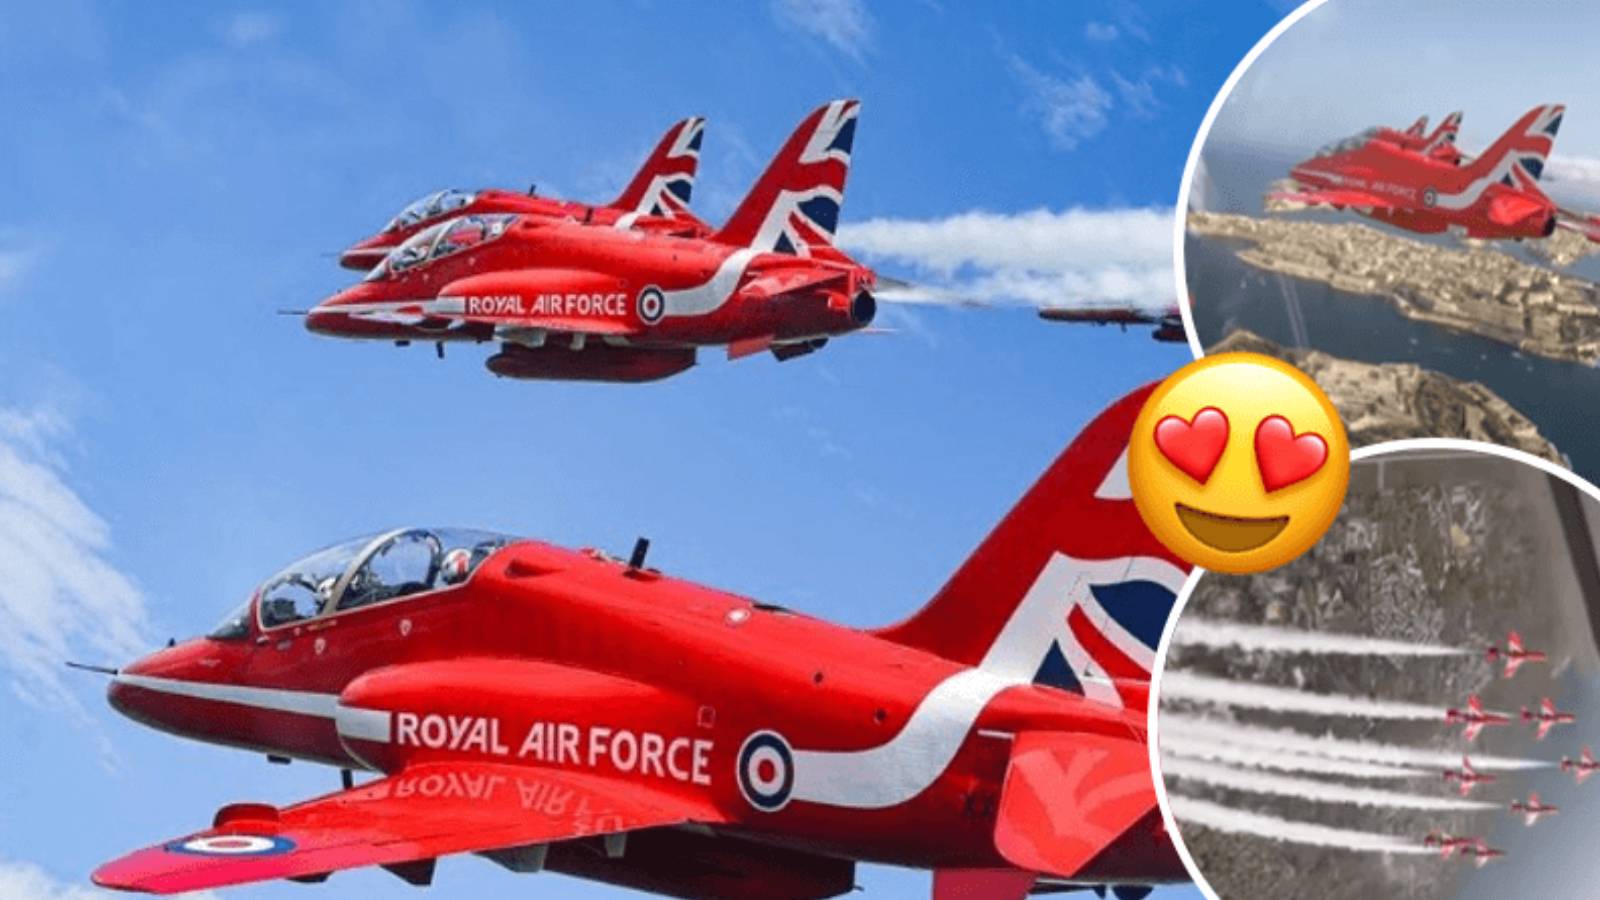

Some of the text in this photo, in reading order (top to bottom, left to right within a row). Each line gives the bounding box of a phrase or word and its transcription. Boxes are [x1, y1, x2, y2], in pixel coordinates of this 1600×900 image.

[469, 293, 627, 315] ROYAL AIR FORCE
[398, 712, 714, 785] ROYAL AIR FORCE
